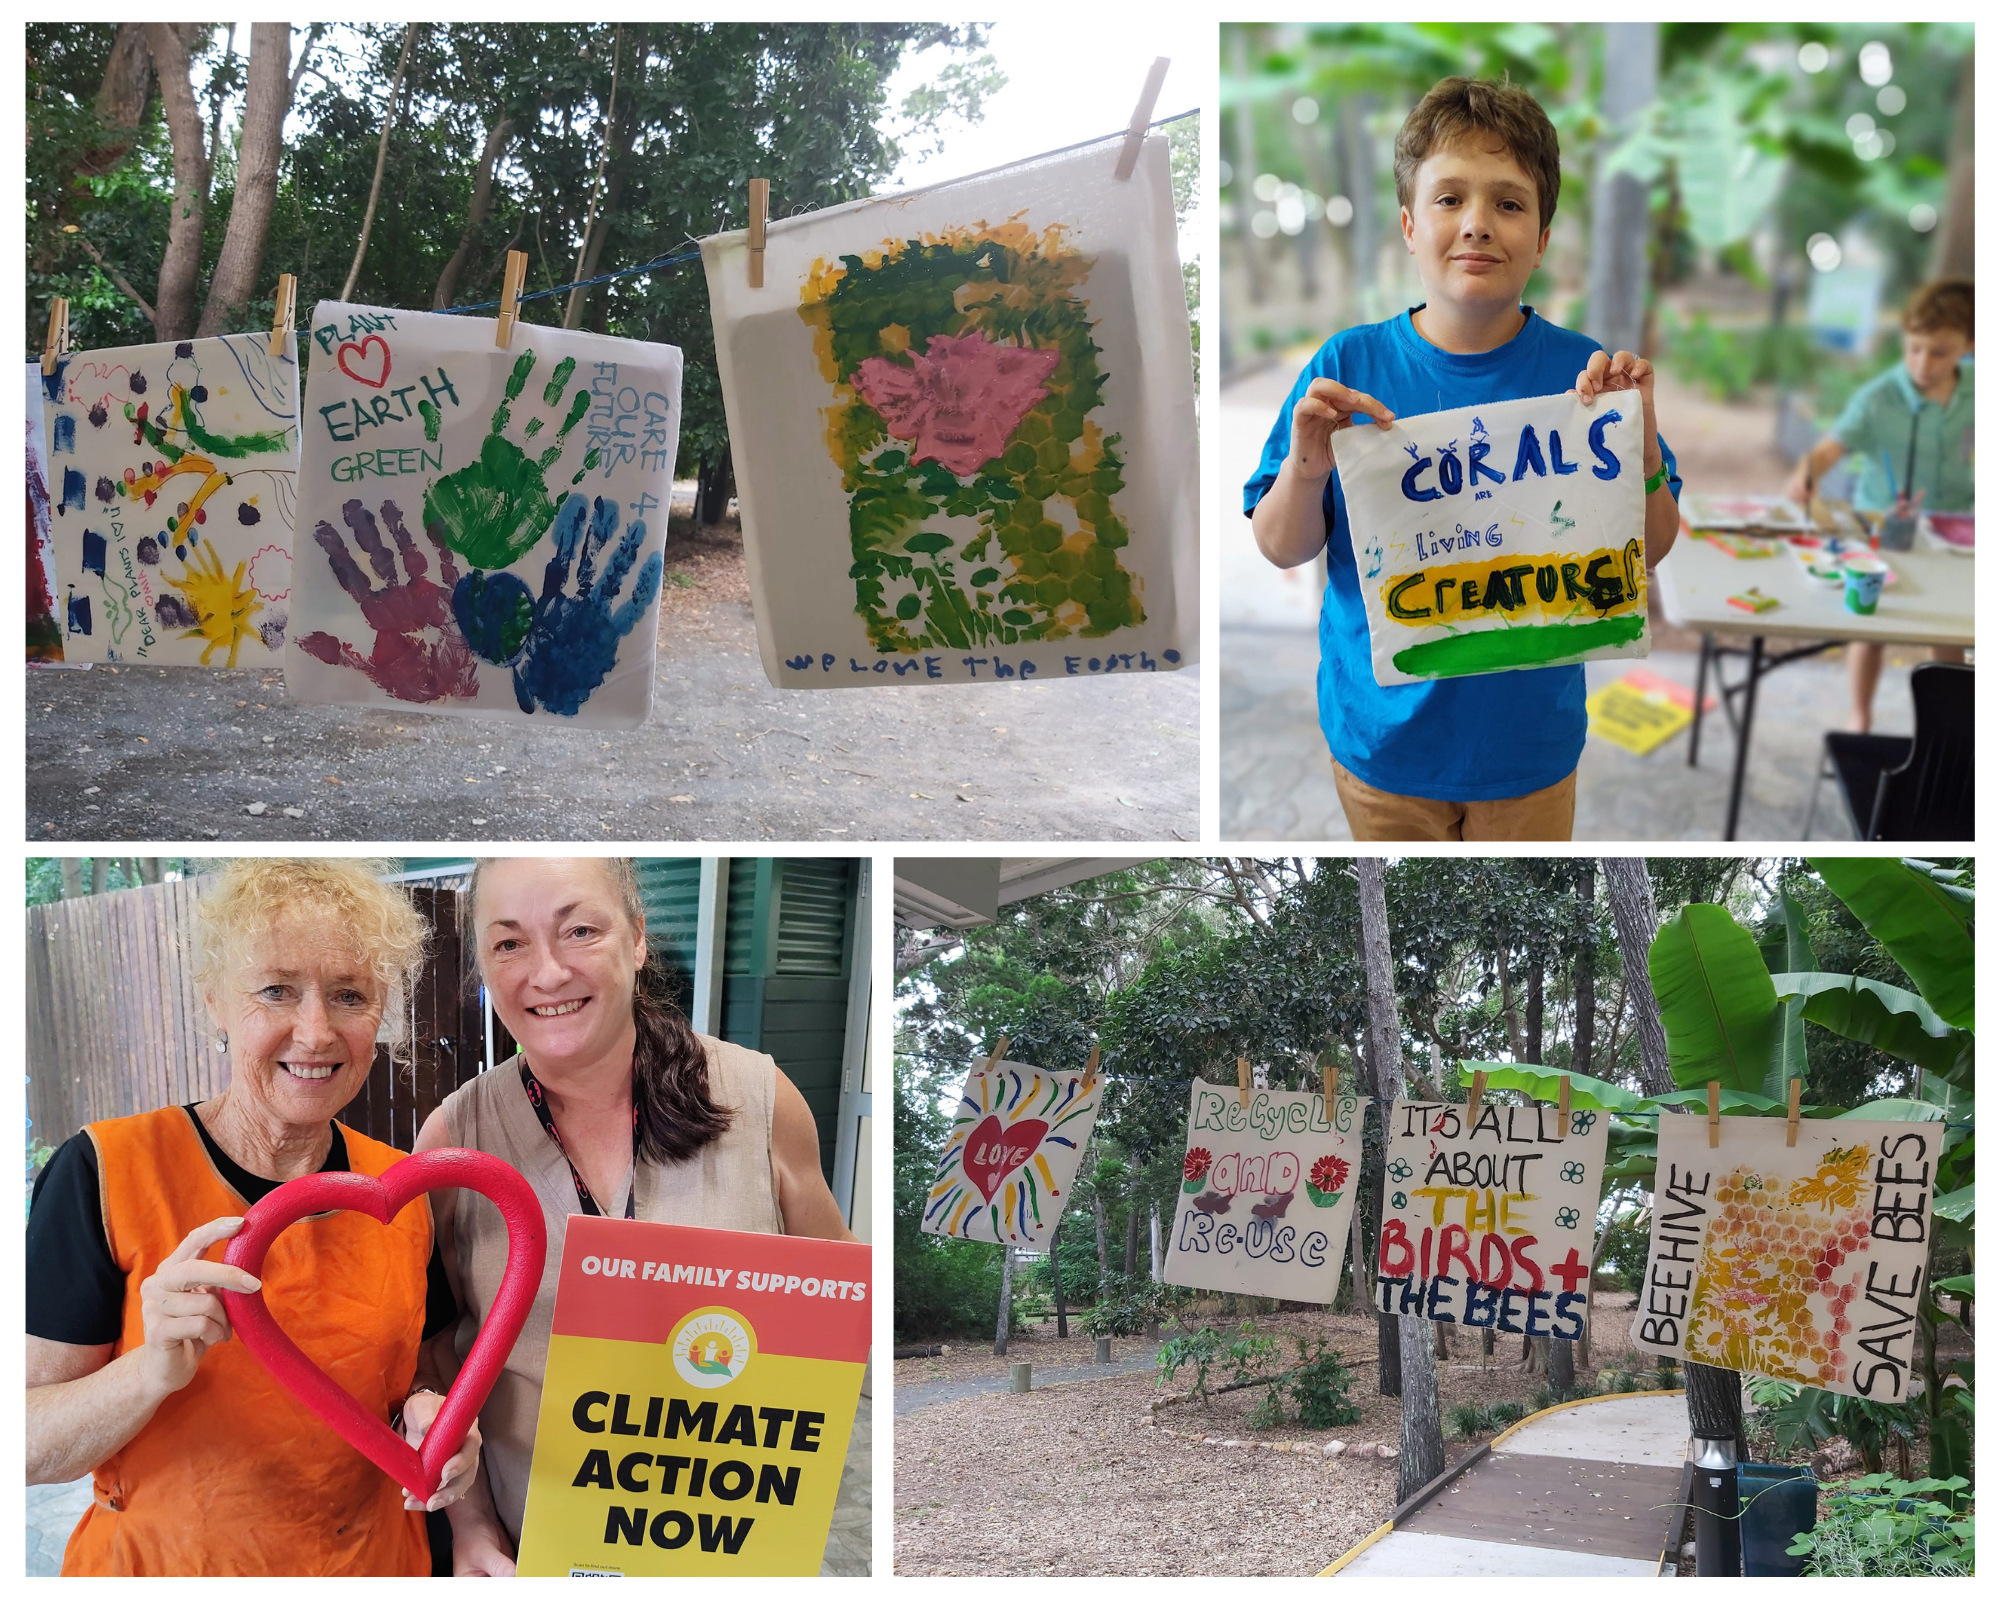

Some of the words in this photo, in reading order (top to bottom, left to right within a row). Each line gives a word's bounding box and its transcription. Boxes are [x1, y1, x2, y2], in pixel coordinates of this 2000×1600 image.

[314, 312, 397, 355] PLANT
[319, 367, 460, 442] EARTH
[583, 361, 617, 468] FUTURE
[640, 391, 669, 472] CARE
[605, 387, 640, 478] OUR
[1401, 408, 1623, 502] CORALS
[331, 443, 444, 483] GREEN
[630, 492, 658, 517] 4
[1475, 490, 1492, 501] ARE
[119, 547, 141, 598] PLANTS
[138, 570, 152, 594] MIA
[1469, 1104, 1564, 1143] ALL
[973, 1142, 1029, 1166] LOVE
[1424, 1151, 1543, 1198] ABOUT
[1410, 1186, 1542, 1234] THE
[1870, 1133, 1929, 1243] BEES
[581, 1255, 636, 1279] OUR
[641, 1261, 733, 1288] FAMILY
[736, 1270, 867, 1301] SUPPORTS
[1380, 1219, 1546, 1298] BIRDS
[1640, 1163, 1710, 1346] BEEHIVE
[1378, 1272, 1459, 1323] THE
[1463, 1277, 1587, 1341] BEES
[1853, 1261, 1921, 1397] SAVE
[572, 1390, 825, 1453] CLIMATE
[571, 1448, 801, 1506] ACTION
[603, 1505, 755, 1555] NOW
